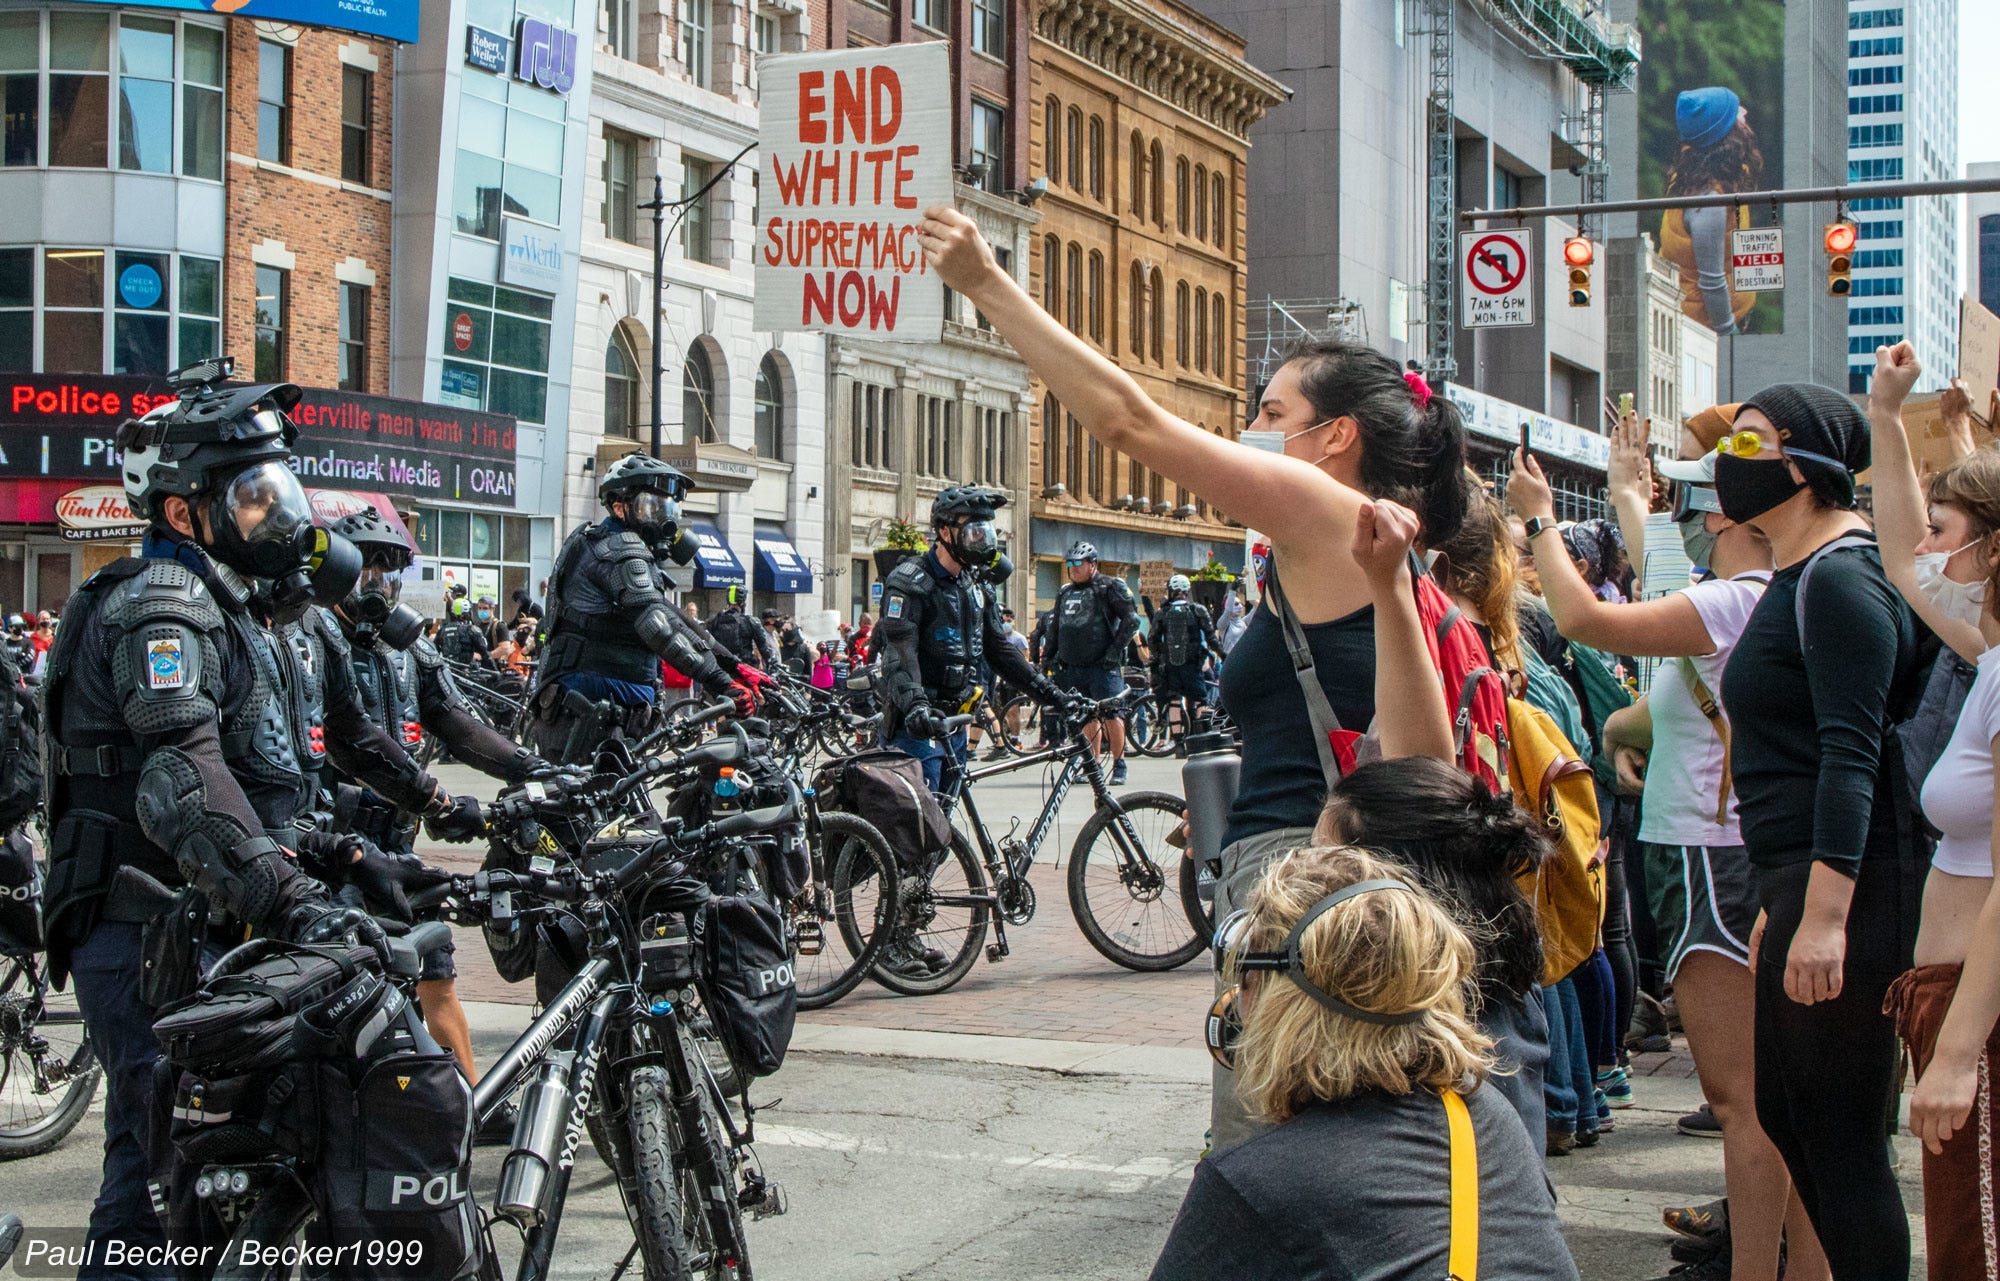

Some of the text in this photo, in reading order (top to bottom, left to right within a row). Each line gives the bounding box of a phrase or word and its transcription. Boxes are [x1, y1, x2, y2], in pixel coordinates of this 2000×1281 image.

[338, 1, 362, 12] PUBLIC
[363, 6, 387, 16] HEALTH
[473, 33, 499, 52] Robert
[472, 45, 497, 64] Weiler
[799, 65, 902, 145] END
[773, 145, 919, 209] WHITE
[1740, 232, 1777, 243] TURNING
[1742, 242, 1775, 252] TRAFFIC
[1737, 254, 1780, 266] YIELD
[127, 276, 154, 286] CHECK
[1736, 275, 1782, 287] PEDESTRIANS
[1755, 267, 1763, 277] TO
[125, 284, 137, 293] ME
[802, 270, 900, 332] NOW
[1470, 297, 1492, 311] 7AM
[1502, 295, 1525, 309] 6PM
[456, 323, 471, 333] GREAT
[12, 384, 121, 415] Police
[378, 412, 413, 436] men
[483, 422, 496, 448] in
[288, 449, 384, 482] andmark
[389, 456, 441, 488] Media
[59, 496, 94, 518] Tim
[311, 499, 339, 518] Tim
[65, 530, 92, 539] CAFE
[101, 528, 128, 537] BAKE
[790, 580, 798, 588] 12
[1029, 765, 1075, 859] CANNONDALE
[0, 878, 43, 901] POL
[518, 973, 599, 1068] COLUMBUS POLICE
[391, 1172, 467, 1206] POL
